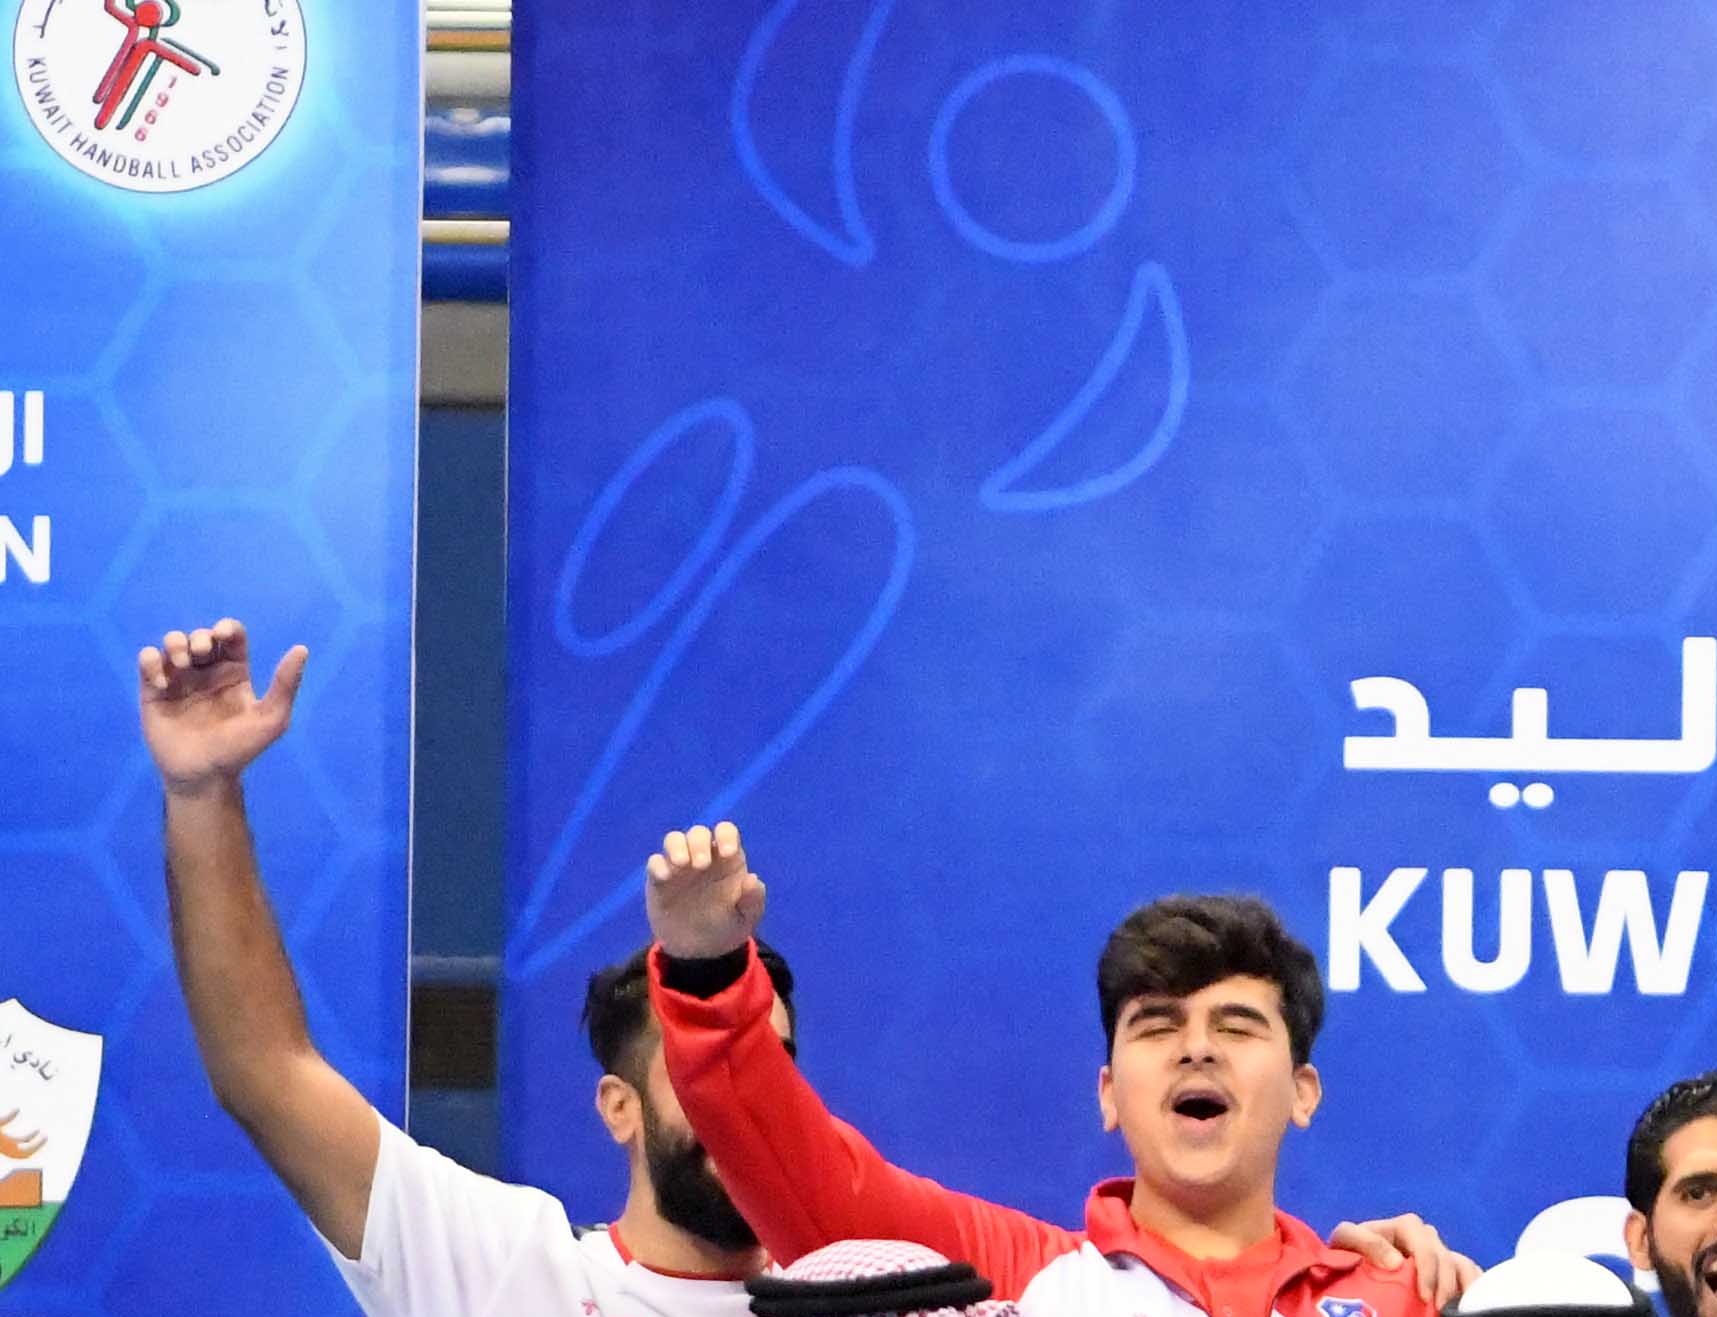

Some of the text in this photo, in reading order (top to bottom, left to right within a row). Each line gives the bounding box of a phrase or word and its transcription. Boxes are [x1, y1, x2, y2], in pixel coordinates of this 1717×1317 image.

[26, 57, 291, 181] KUWAIT HANDBALL ASSOCIATION
[133, 75, 178, 143] 1966
